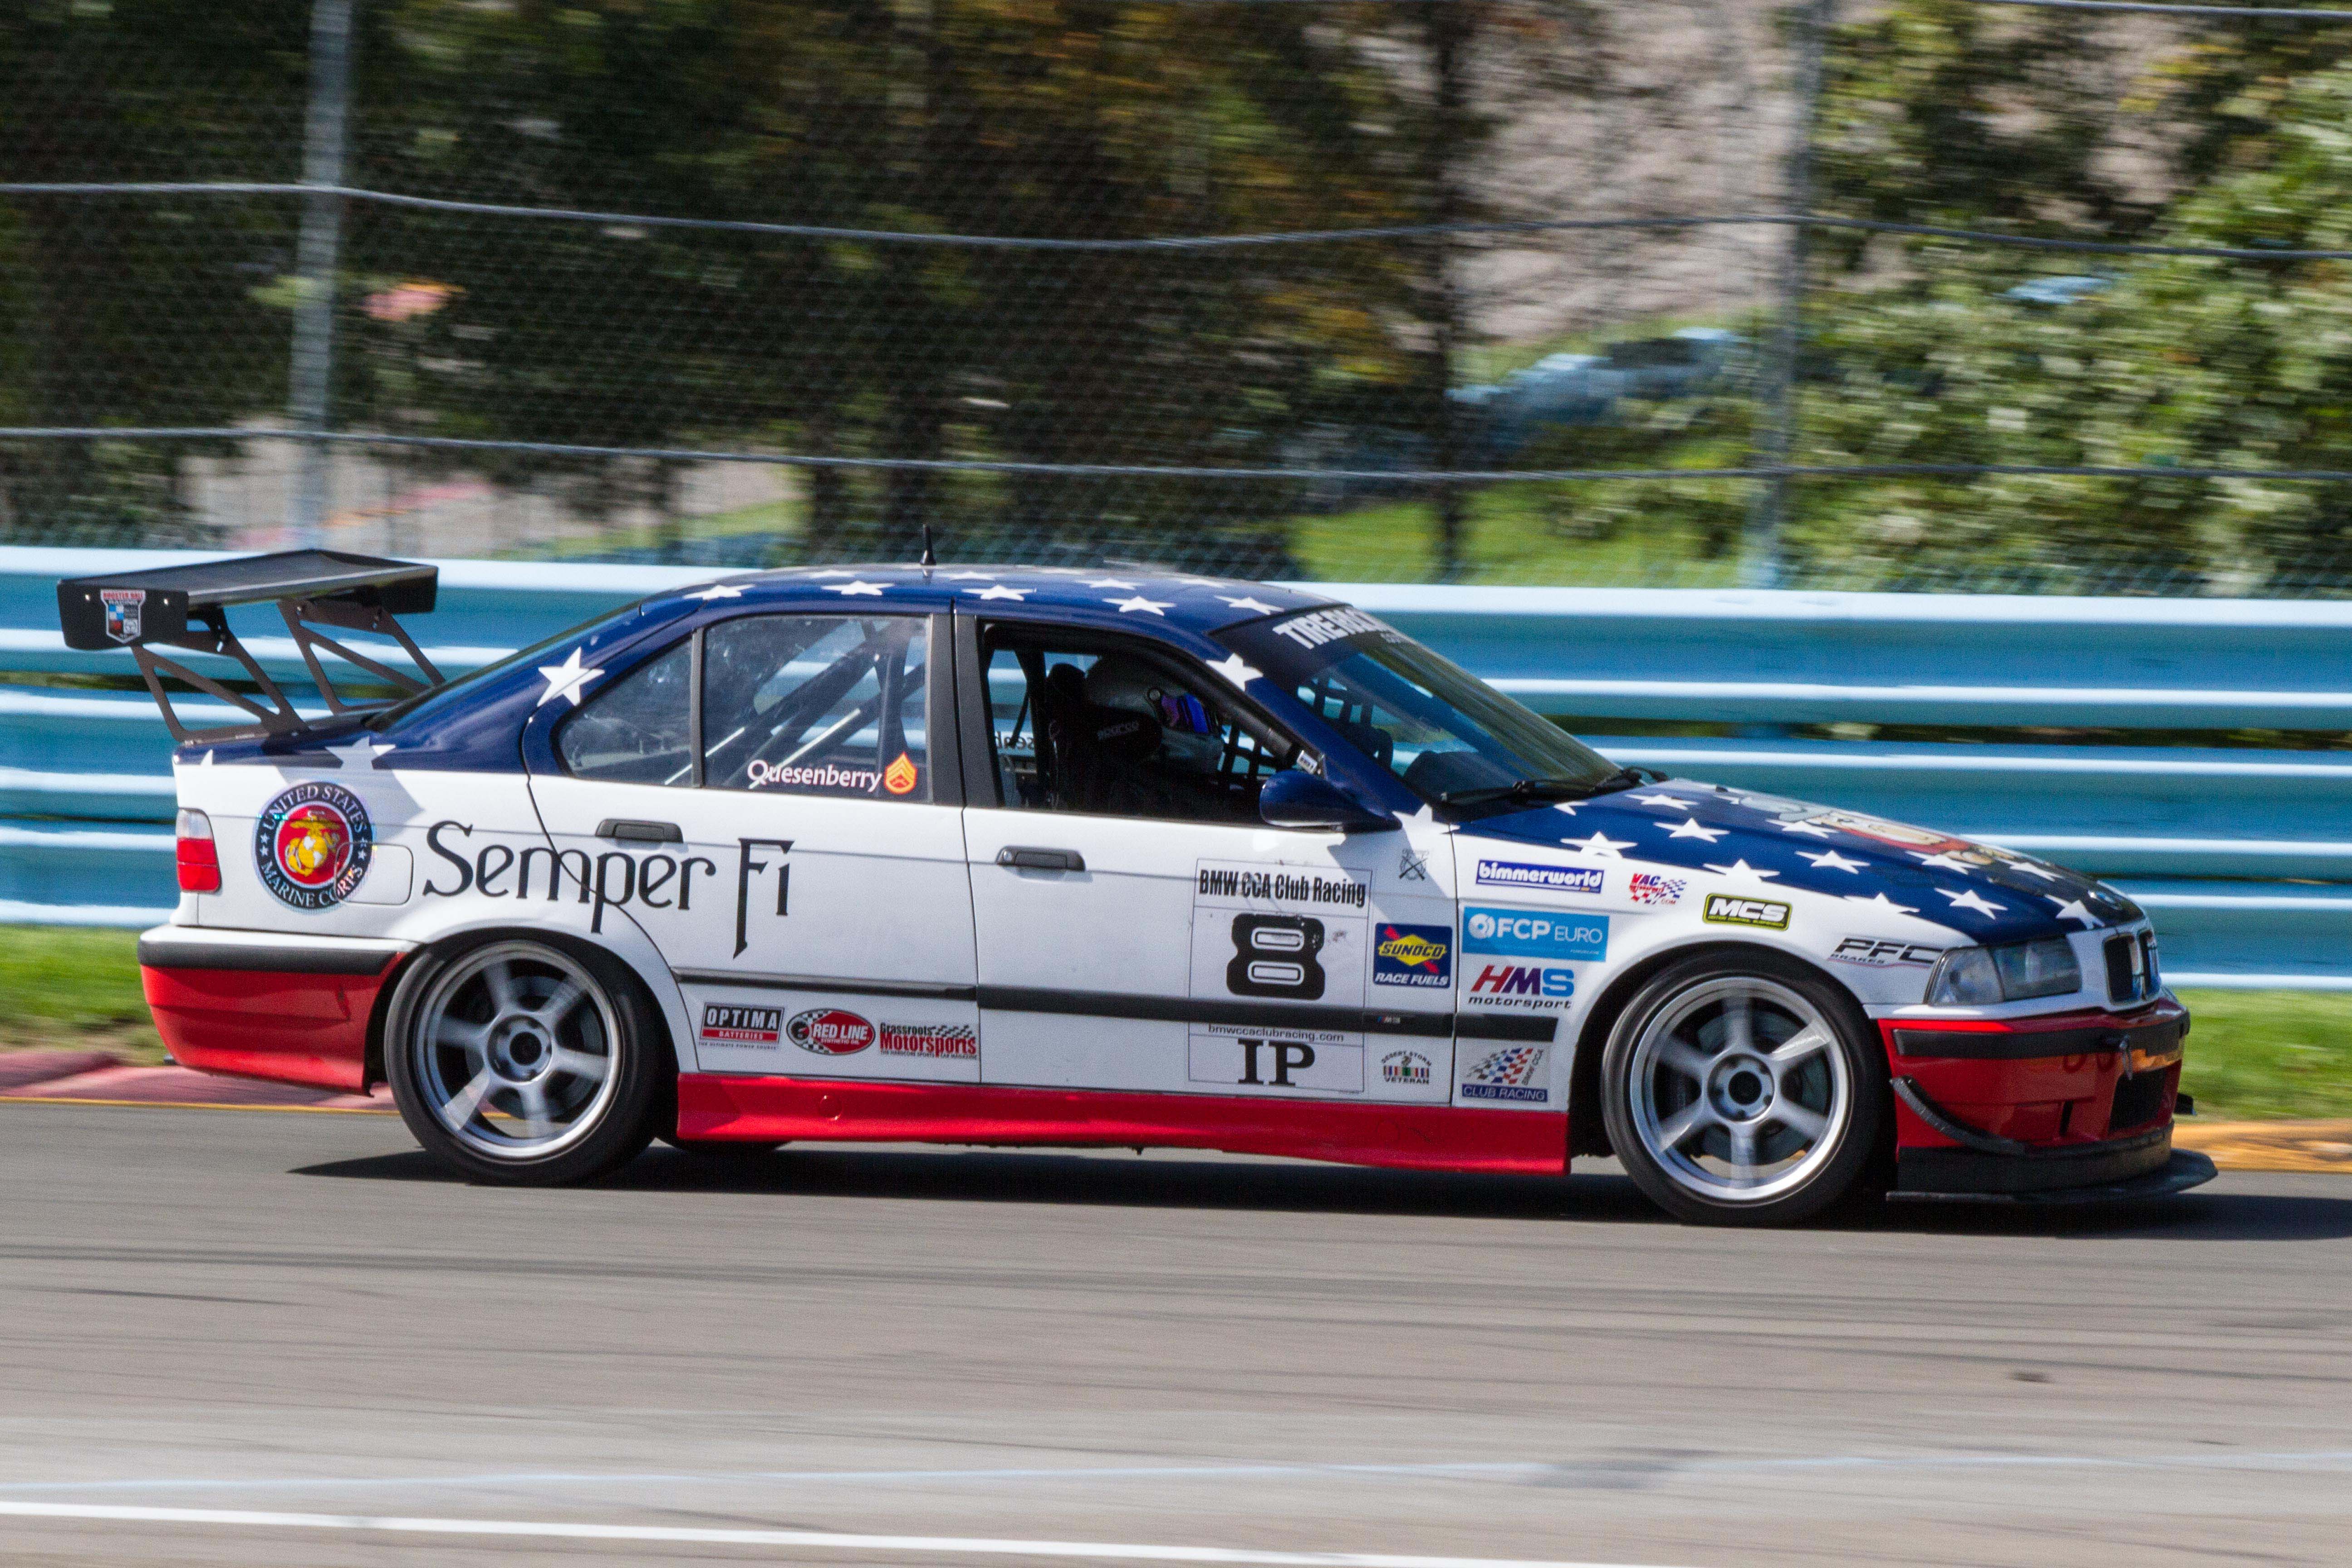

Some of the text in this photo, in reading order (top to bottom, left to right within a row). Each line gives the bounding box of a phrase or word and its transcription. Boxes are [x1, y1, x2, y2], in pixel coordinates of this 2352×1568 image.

[747, 760, 883, 793] Quesenberry
[262, 785, 367, 833] UNITED STATES
[261, 861, 363, 906] MARINE CORPS
[1479, 862, 1602, 887] bimmerworld
[1632, 873, 1661, 886] VAC
[423, 820, 795, 960] Semper Fi
[1199, 869, 1367, 908] BMW CCA Club Racing
[1709, 897, 1788, 922] MCS
[1497, 917, 1603, 944] FCP EURO
[1226, 913, 1325, 1000] 8
[1382, 943, 1443, 957] SUNOCO
[1831, 953, 1885, 964] BRAKES
[1834, 938, 1945, 965] PFC
[1375, 972, 1449, 986] RACE FUELS
[1470, 964, 1574, 997] HMS
[1468, 996, 1572, 1009] motorsport
[707, 1008, 778, 1030] OPTIMA
[880, 1022, 932, 1036] Grassroots
[718, 1030, 763, 1040] BATTERIES
[813, 1023, 869, 1041] RED LINE
[1208, 1024, 1344, 1042] bmwccaclubracing.com
[880, 1031, 976, 1058] Motorsports
[1238, 1037, 1315, 1086] IP
[1381, 1050, 1432, 1066] DESERT STORM
[1384, 1076, 1429, 1084] VETERAN
[1463, 1086, 1545, 1101] CLUB RACING
